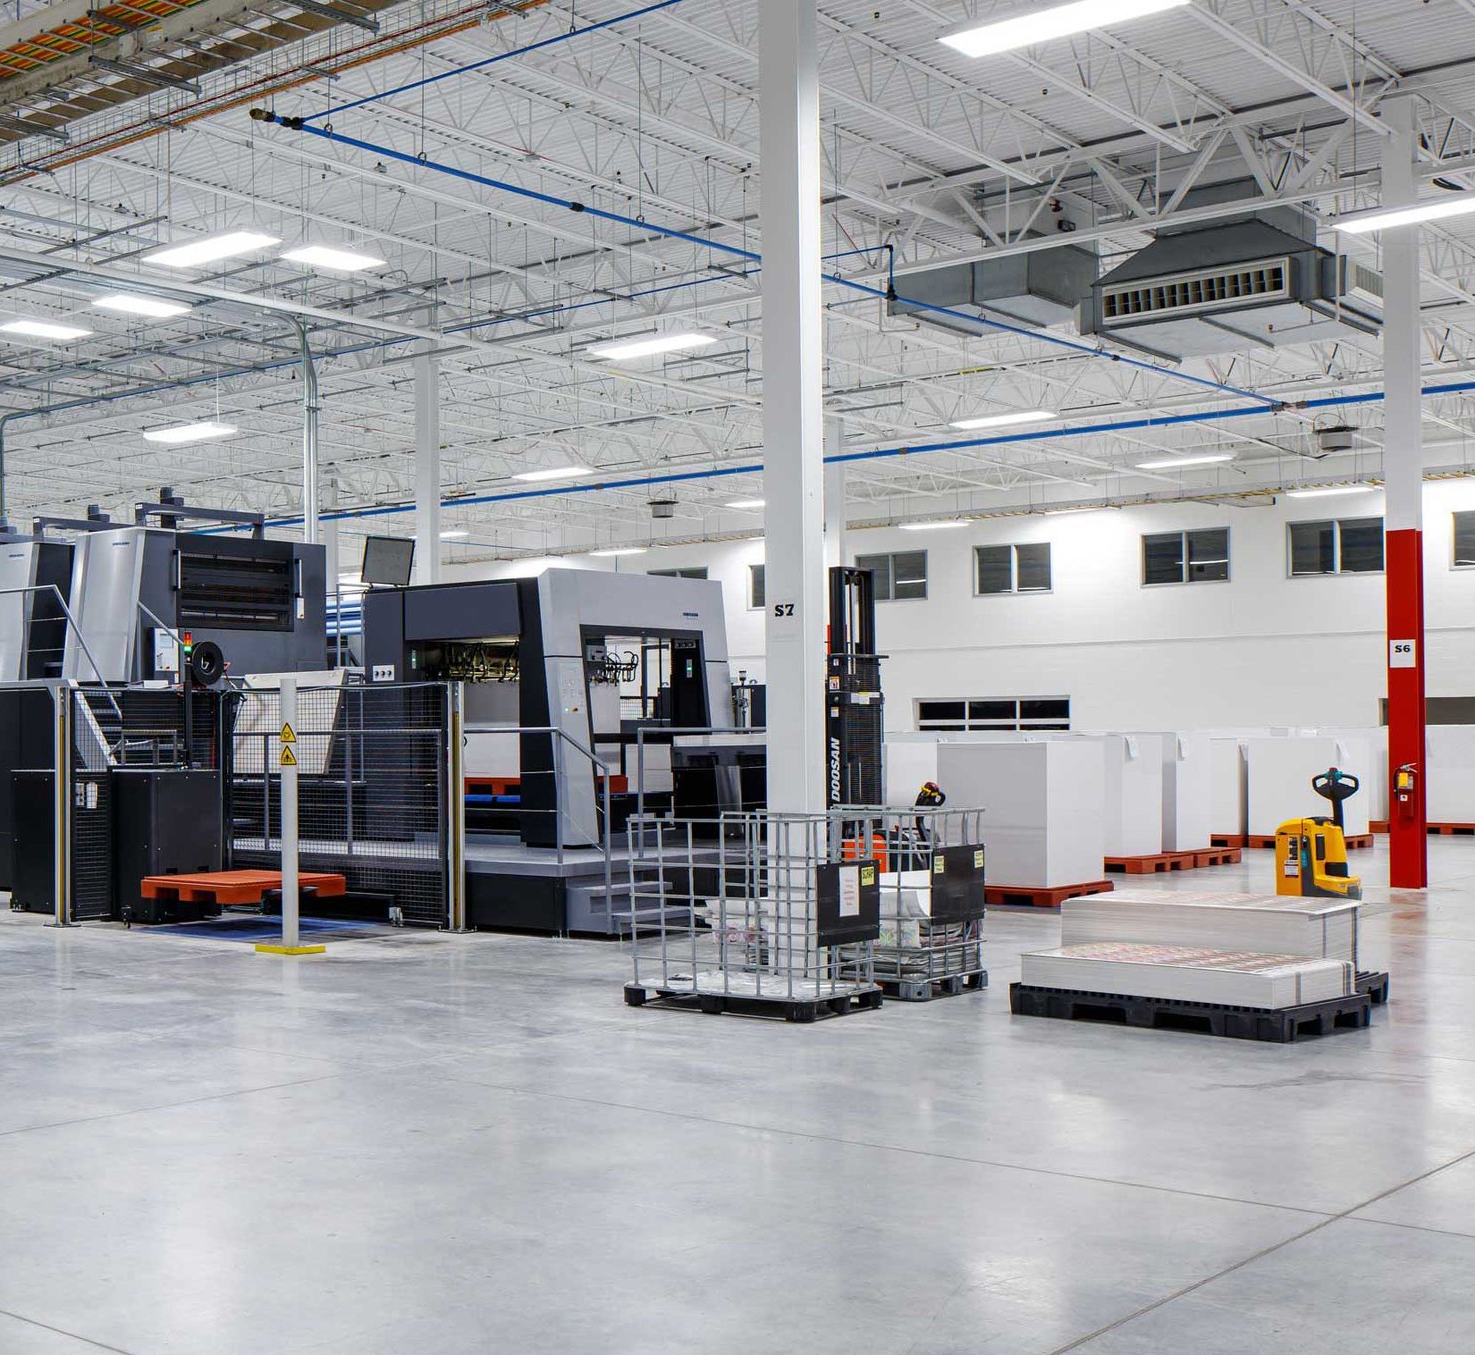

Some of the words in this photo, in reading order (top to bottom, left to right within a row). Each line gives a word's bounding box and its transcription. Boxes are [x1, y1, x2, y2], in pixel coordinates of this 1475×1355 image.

[774, 603, 795, 617] S7
[1394, 644, 1411, 653] S6
[830, 737, 841, 802] DOOSAN
